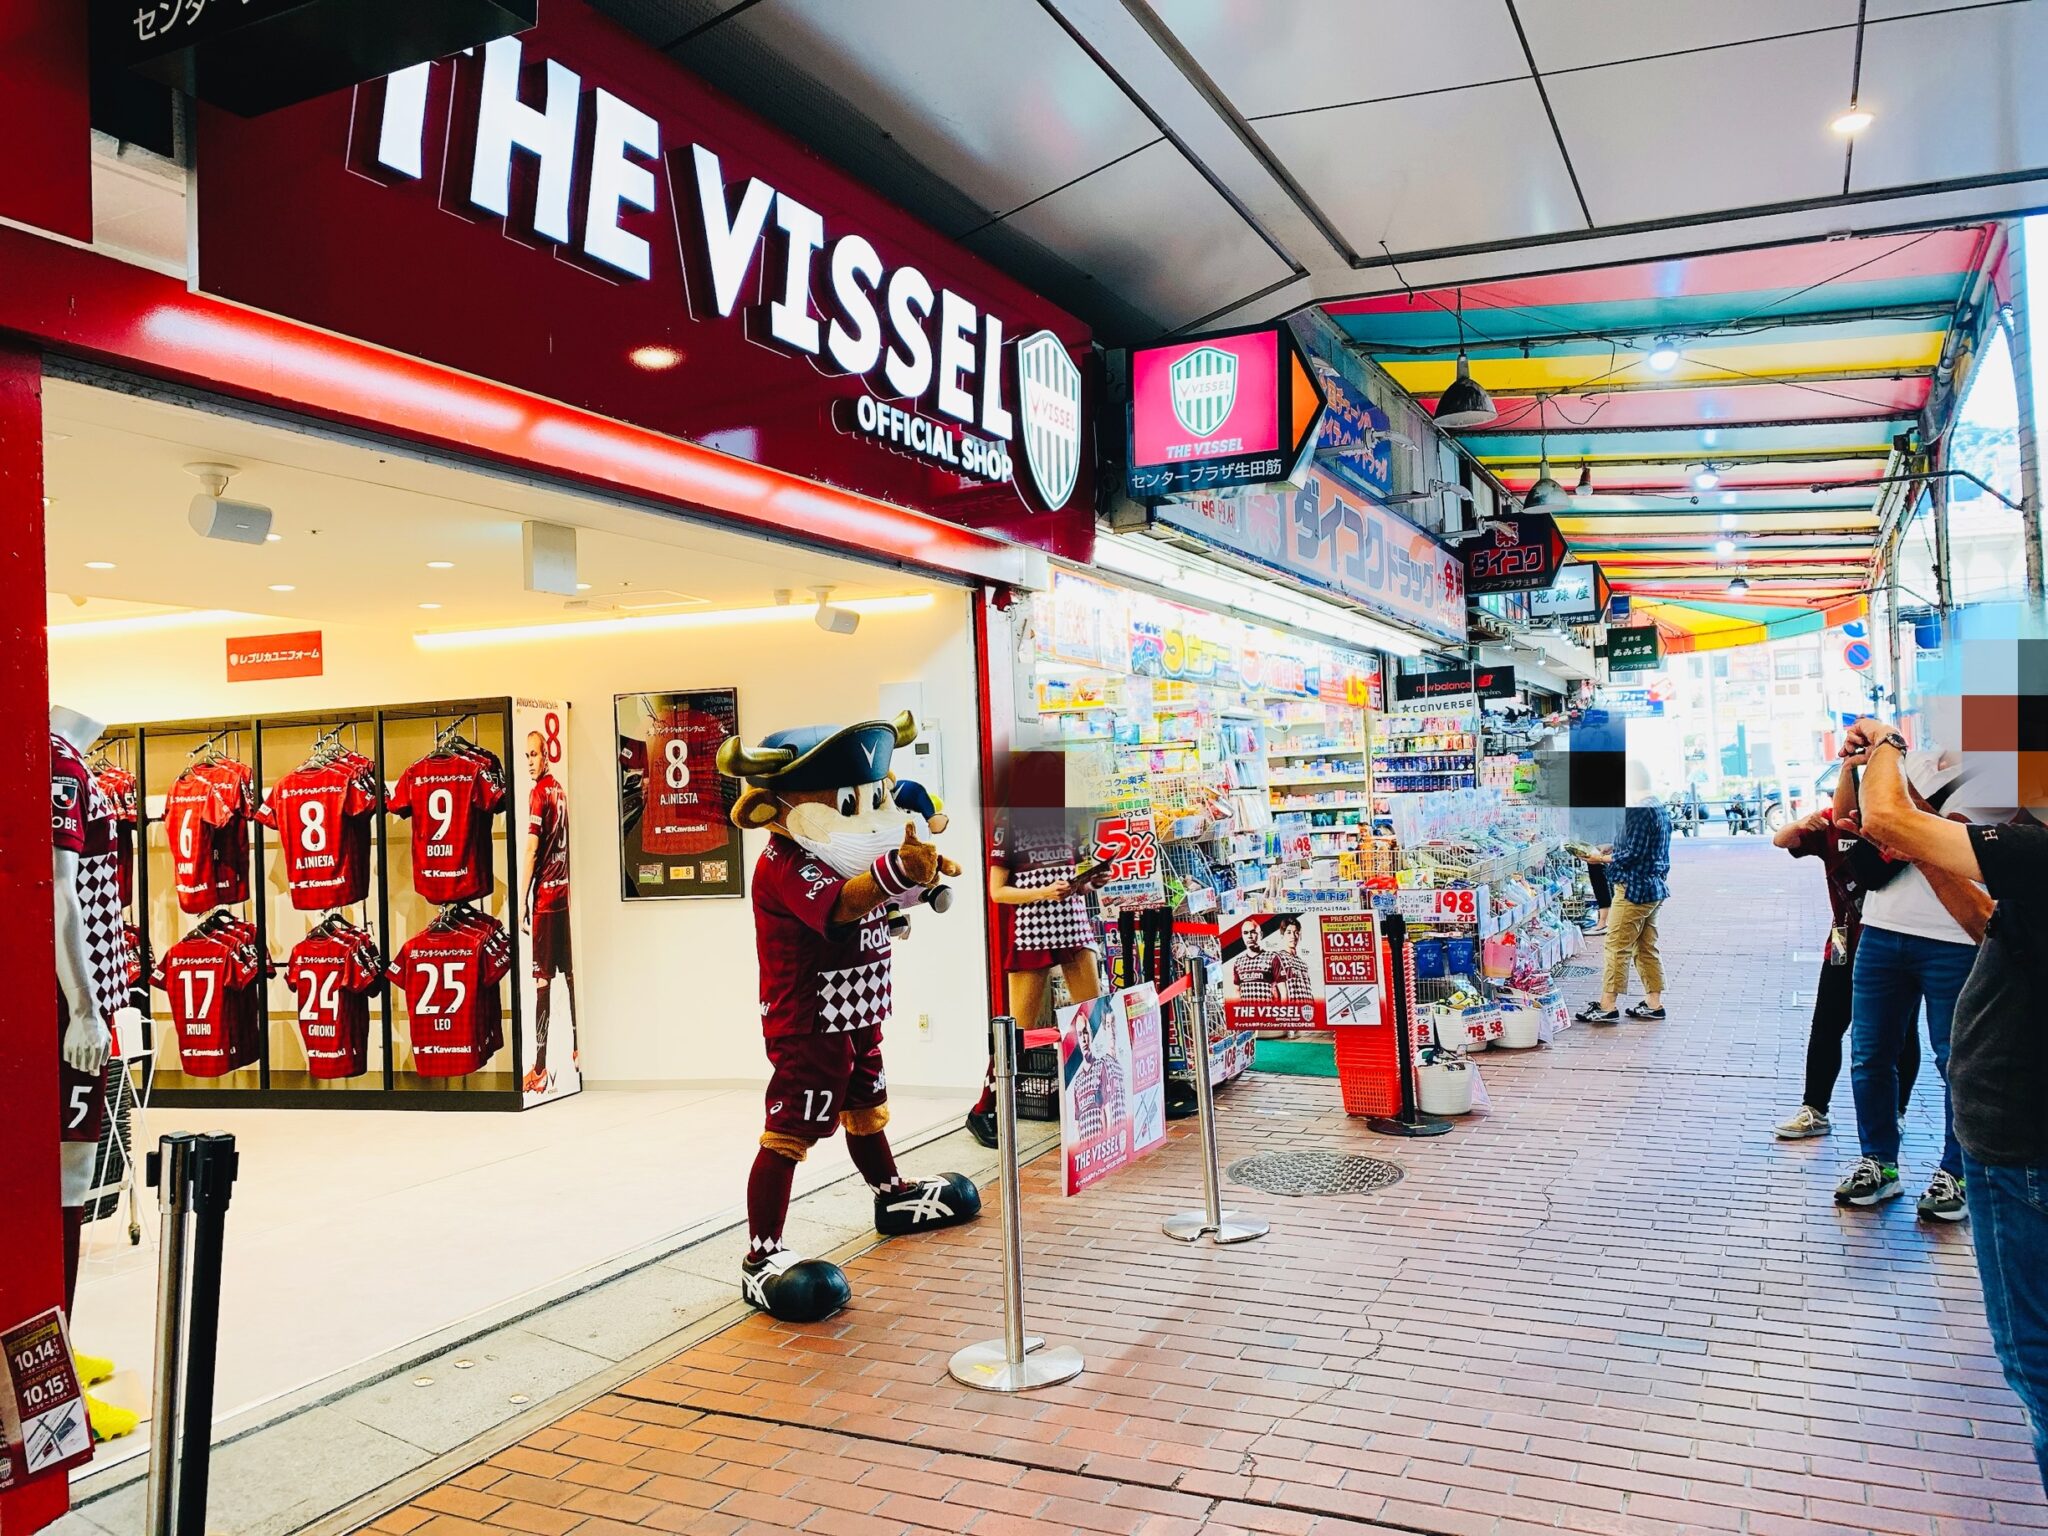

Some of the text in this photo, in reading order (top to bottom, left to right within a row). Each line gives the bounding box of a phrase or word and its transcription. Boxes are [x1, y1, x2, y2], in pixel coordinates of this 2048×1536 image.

[692, 143, 1013, 441] VISSEL
[1192, 380, 1230, 394] VISSEL
[1041, 399, 1075, 432] VISSEL
[857, 395, 1014, 483] OFFICIAL SHOP
[1166, 437, 1244, 459] THE VISSEL
[1131, 457, 1283, 490] センタープラザ生田筋
[1294, 476, 1434, 609] ダイコクドラッグ
[1472, 545, 1543, 578] ダイコク
[239, 648, 321, 665] レプリカユニフォーム
[1613, 644, 1653, 657] あみだ堂
[1412, 699, 1473, 713] CONVERSE
[545, 712, 562, 764] 8
[664, 739, 690, 789] 8
[52, 816, 77, 832] OBE
[299, 800, 327, 852] 8
[428, 788, 454, 841] 9
[671, 823, 708, 834] Kawasaki
[179, 808, 193, 859] 6
[1456, 914, 1476, 922] 213
[1327, 933, 1365, 948] 10.14
[1328, 961, 1366, 976] 10.15
[178, 970, 215, 1020] 17
[299, 969, 340, 1021] 24
[415, 962, 466, 1015] 25
[434, 1018, 451, 1031] LEO
[1233, 1005, 1301, 1018] THE VISSEL
[433, 1045, 472, 1054] Kawasaki
[68, 1085, 93, 1129] 5
[803, 1089, 833, 1122] 12
[1075, 1150, 1091, 1173] THE
[1091, 1135, 1120, 1162] VISSEL
[14, 1340, 55, 1371] 10.14
[23, 1376, 65, 1407] 10.15
